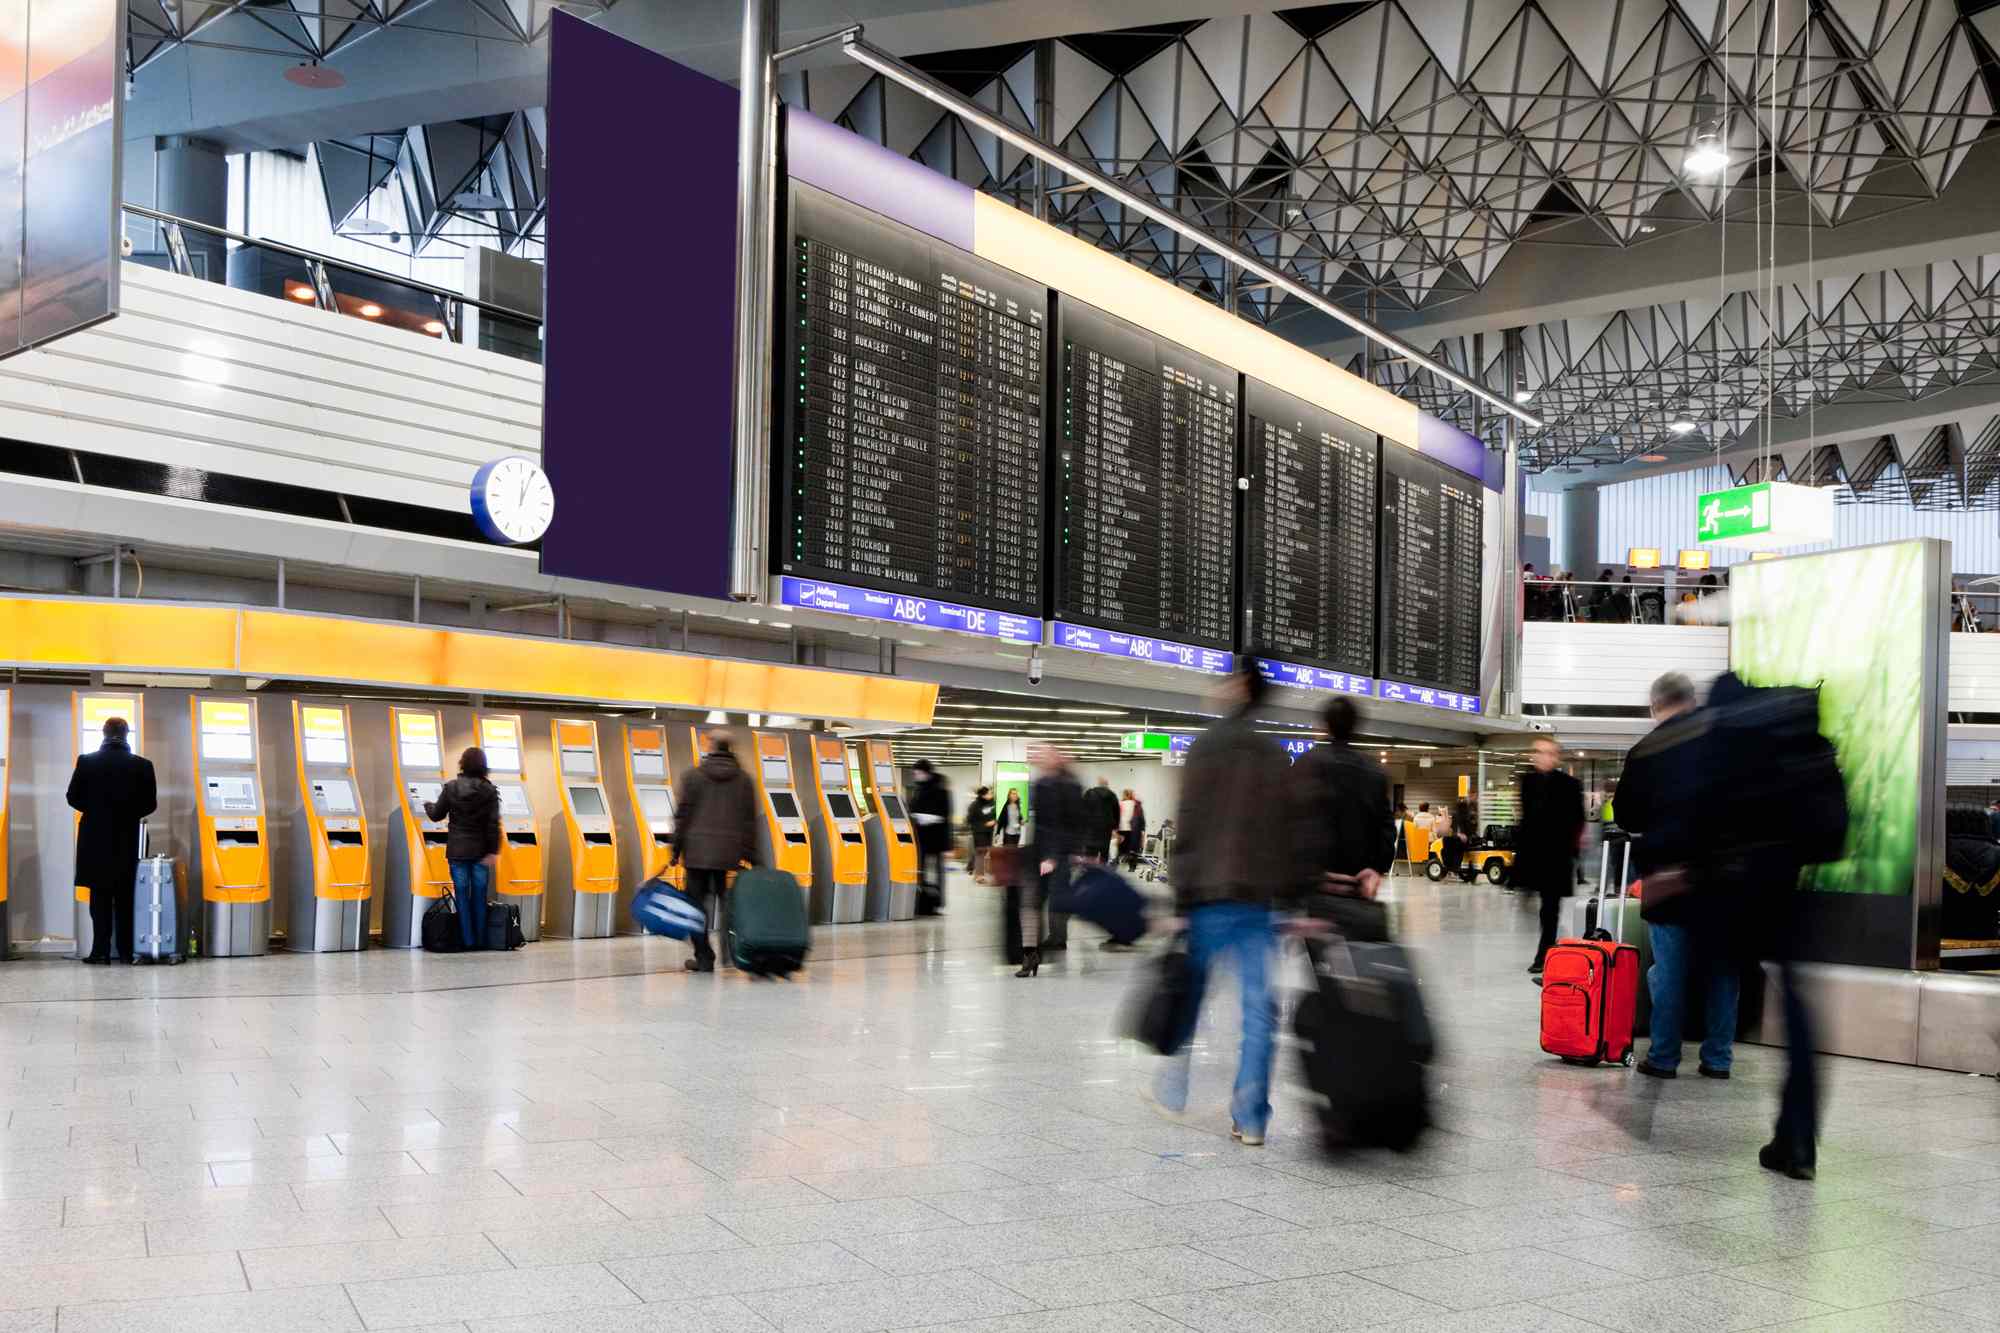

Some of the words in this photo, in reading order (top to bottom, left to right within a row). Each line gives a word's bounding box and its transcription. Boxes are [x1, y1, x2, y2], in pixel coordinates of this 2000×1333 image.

[893, 598, 927, 622] ABC
[967, 610, 986, 631] DE
[1129, 638, 1152, 658] ABC
[1180, 646, 1194, 664] DE
[1296, 668, 1313, 685] ABC
[1333, 674, 1344, 689] DE
